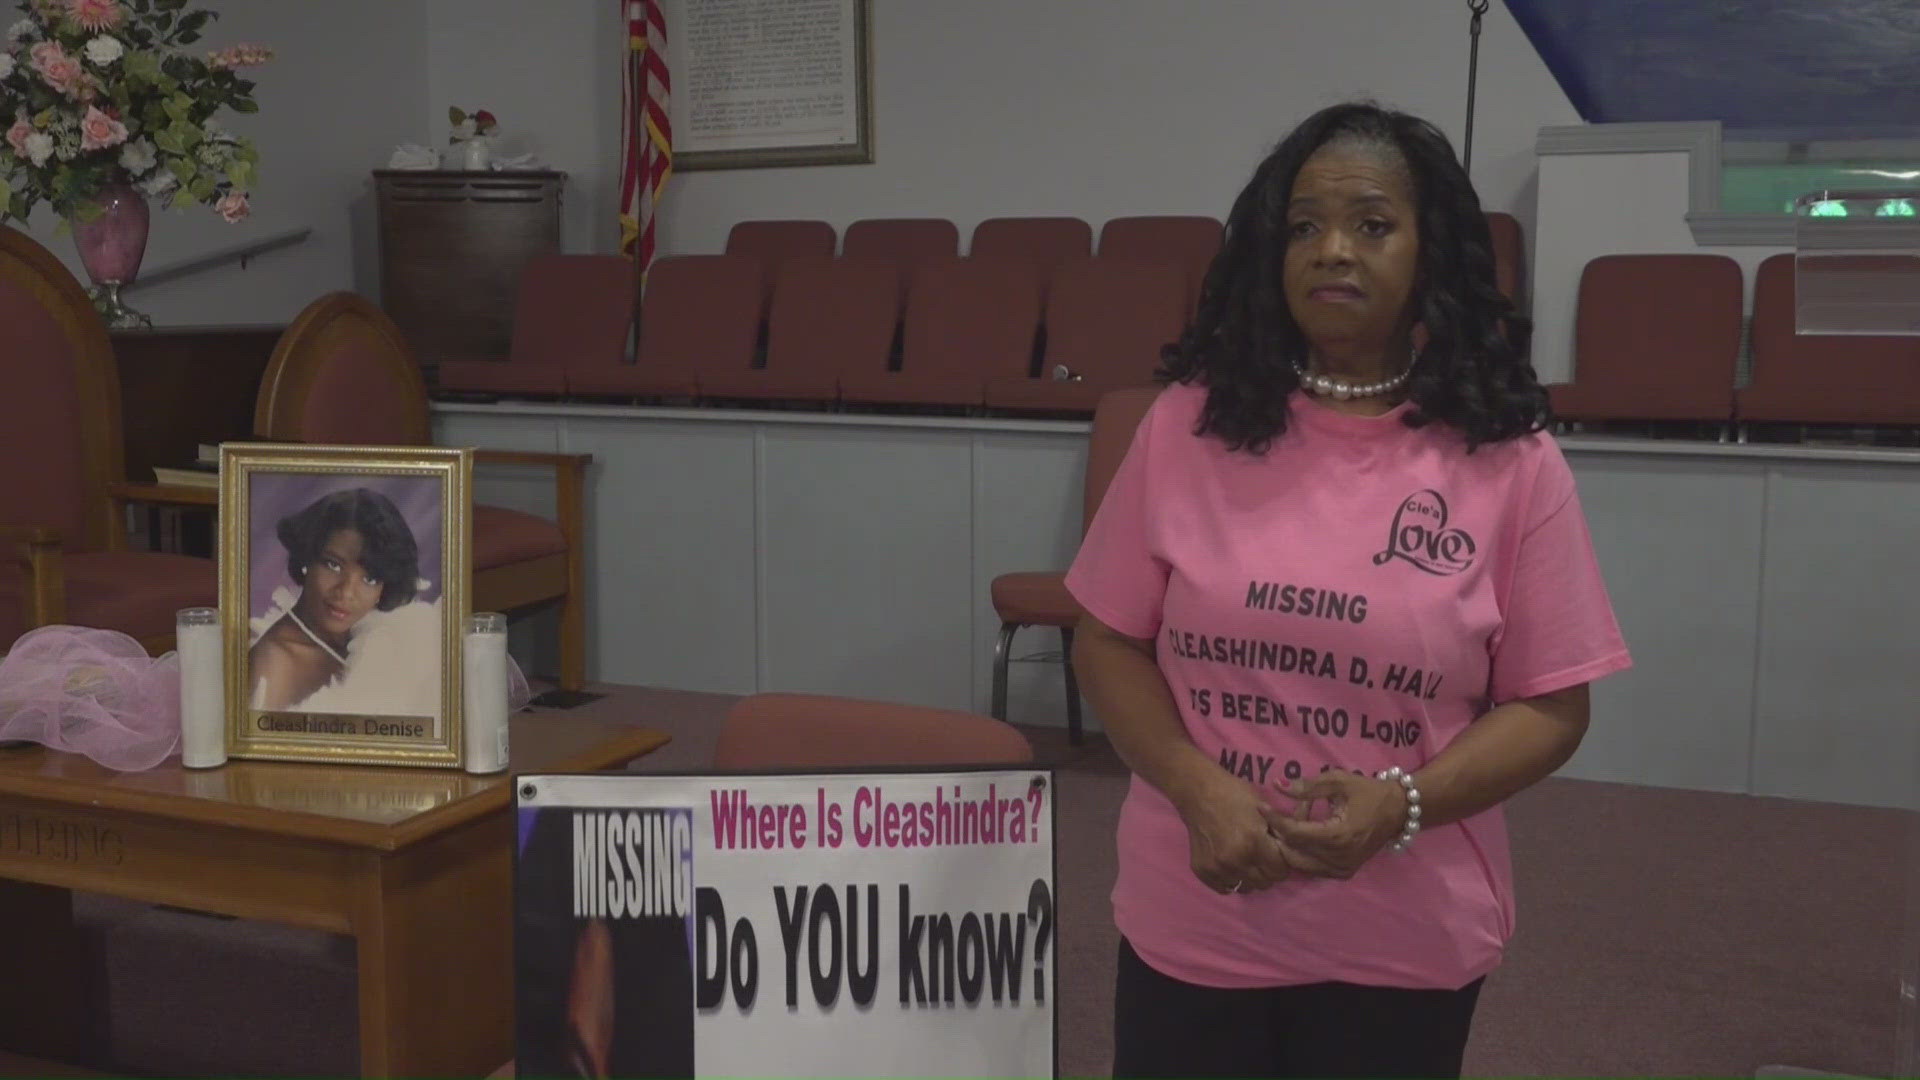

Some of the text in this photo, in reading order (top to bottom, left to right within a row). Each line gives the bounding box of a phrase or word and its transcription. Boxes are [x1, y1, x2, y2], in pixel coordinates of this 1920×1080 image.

[1372, 488, 1476, 576] Love
[1245, 580, 1368, 624] MISSING
[1349, 656, 1374, 688] D.
[256, 714, 424, 738] Cleashindra Denise
[1221, 692, 1289, 727] BEEN
[1297, 705, 1349, 738] TOO
[1360, 714, 1421, 749] LONG
[1219, 747, 1275, 785] MAY
[710, 784, 1043, 850] Where Is Cleashindra?
[572, 811, 692, 919] MISSING
[695, 878, 1052, 1010] Do YOU know?
